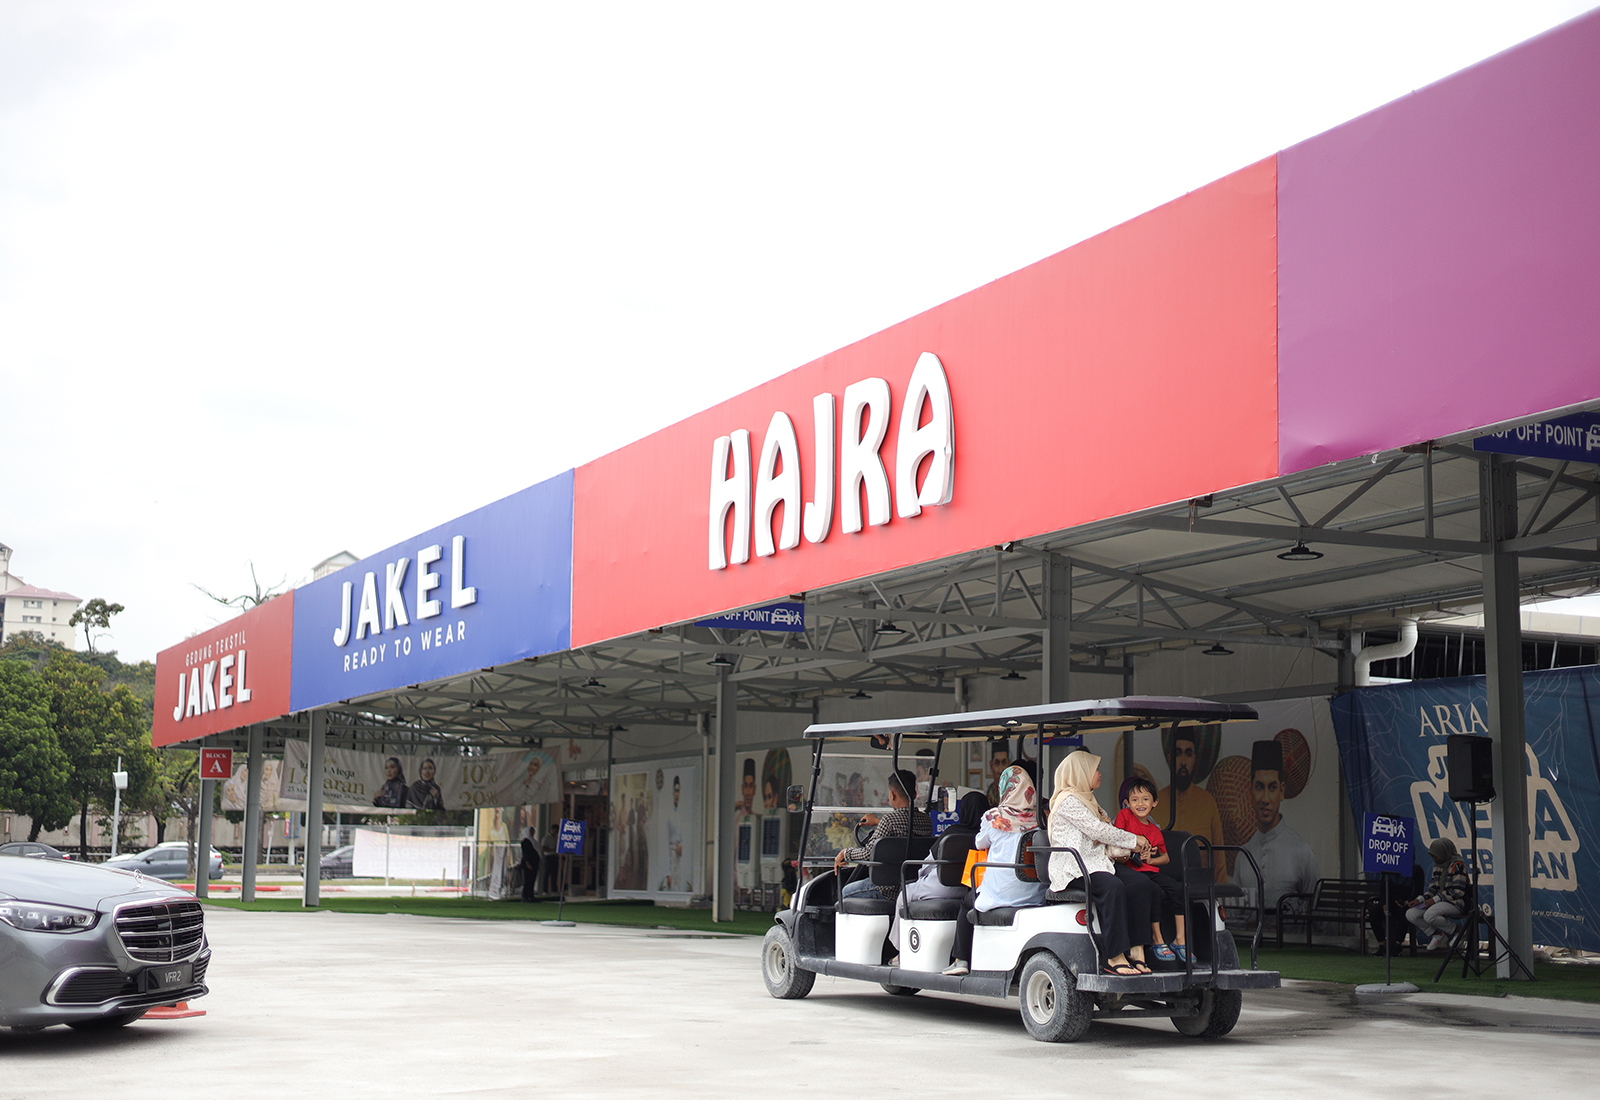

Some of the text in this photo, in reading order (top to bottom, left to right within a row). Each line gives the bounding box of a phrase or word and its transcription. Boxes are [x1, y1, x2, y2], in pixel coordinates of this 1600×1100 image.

[1545, 424, 1584, 446] POINT
[708, 351, 955, 570] HAJRA
[333, 535, 477, 647] JAKEL
[743, 609, 770, 622] POINT
[186, 630, 246, 667] GEDUNG TEKSTIL
[343, 620, 466, 672] READY TO WEAR
[173, 649, 251, 722] JAKEL
[209, 759, 223, 773] A
[462, 764, 498, 784] 10%
[458, 789, 498, 807] 20%
[560, 833, 582, 842] DROP OFF
[563, 841, 577, 849] POINT
[1368, 838, 1409, 854] DROP OFF
[1376, 852, 1400, 866] POINT
[912, 934, 918, 946] 6
